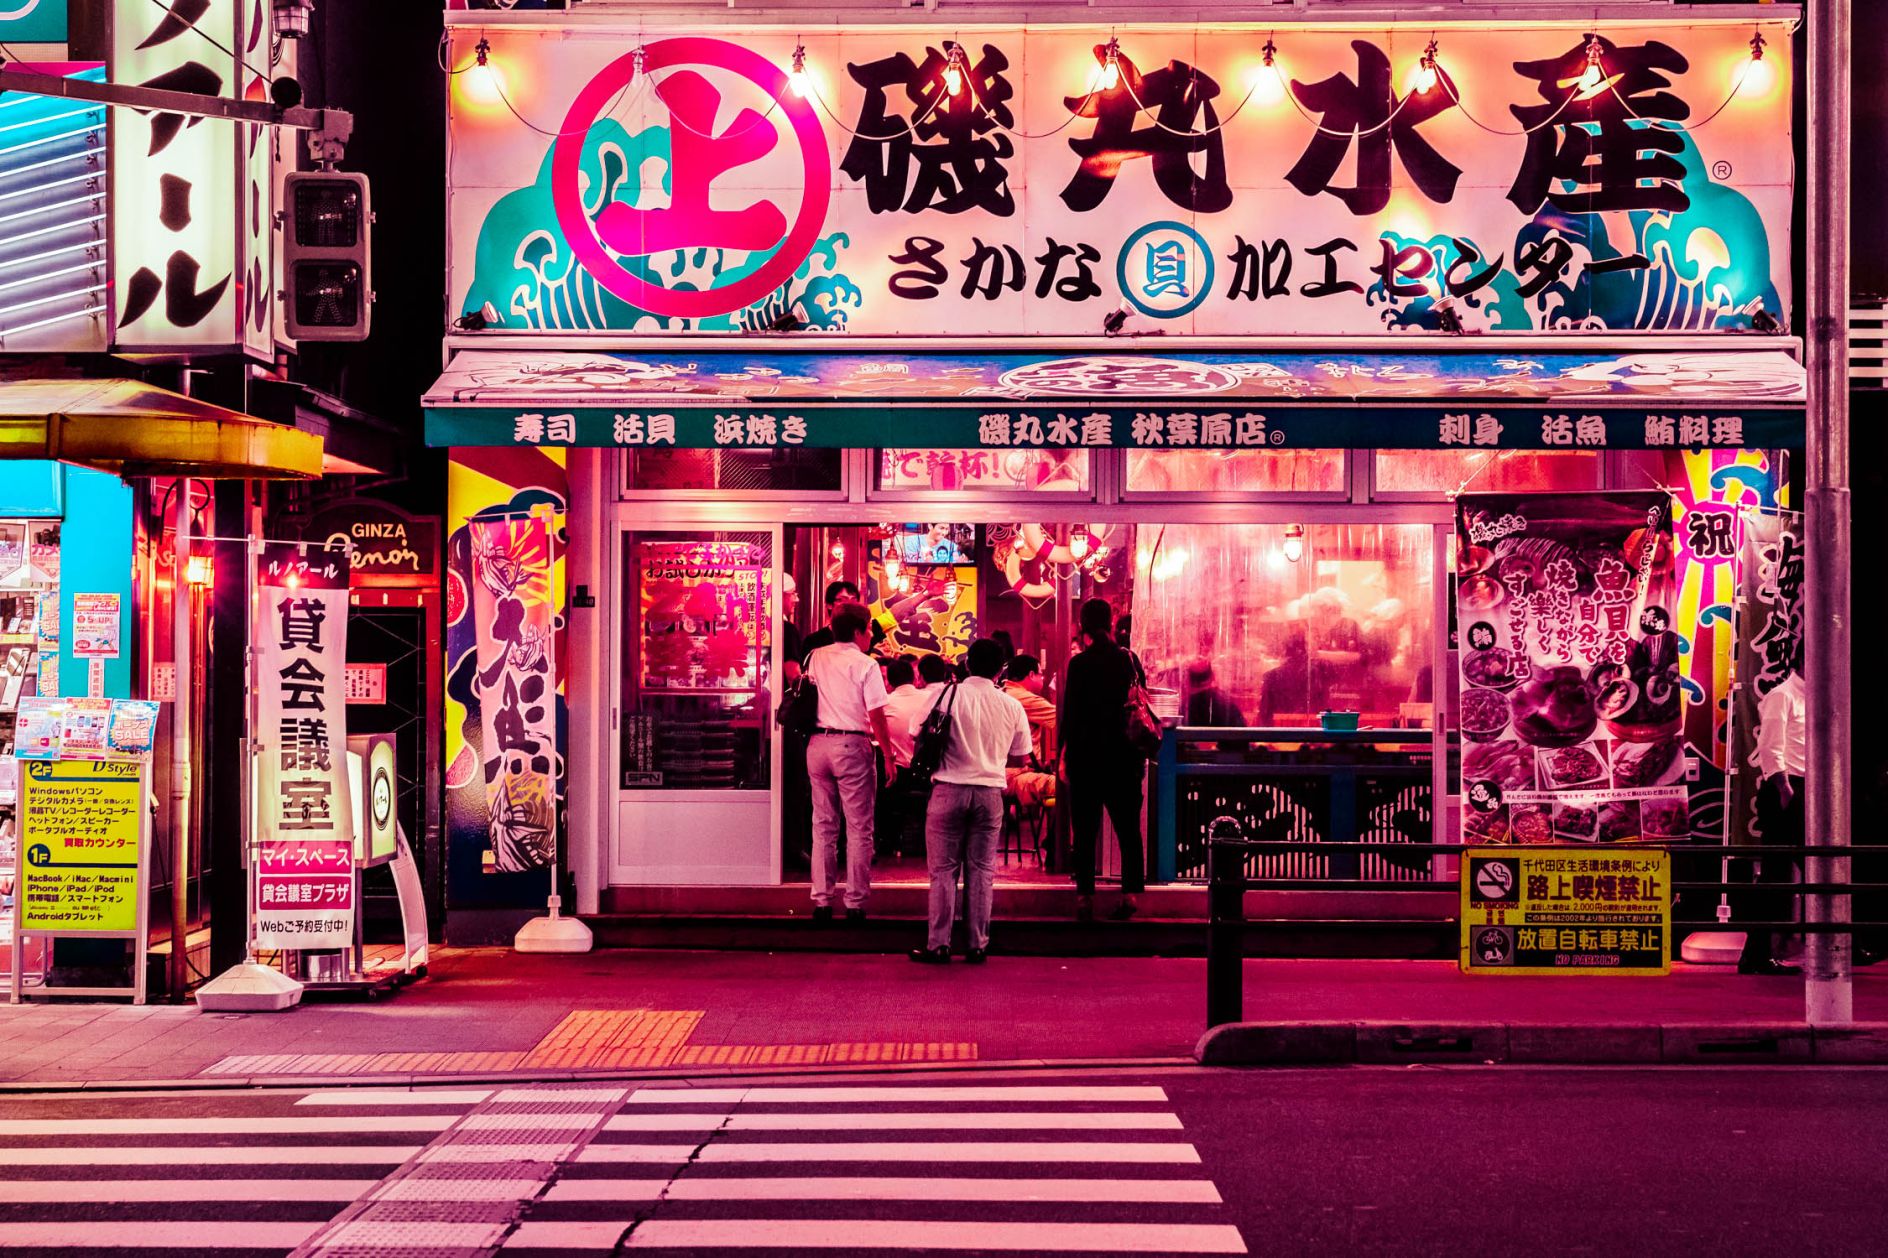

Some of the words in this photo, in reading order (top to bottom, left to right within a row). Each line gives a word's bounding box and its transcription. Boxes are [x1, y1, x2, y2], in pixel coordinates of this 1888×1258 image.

[840, 33, 1691, 217] 磯丸水産
[514, 413, 577, 443] 寿司
[614, 413, 676, 445] 活貝
[714, 414, 808, 445] 浜焼き
[978, 412, 1113, 446] 磯丸水産
[1131, 412, 1267, 446] 秋葉原店
[1439, 413, 1504, 446] 刺身
[1542, 413, 1607, 446] 活魚
[1644, 413, 1745, 446] 鮪料理
[352, 522, 407, 538] GINZA
[1688, 511, 1736, 558] 祝
[268, 560, 339, 579] ルノアール
[1544, 558, 1579, 663] 焼きながら
[1591, 557, 1637, 665] 魚貝を
[1503, 571, 1532, 679] すごせる店
[1526, 590, 1555, 655] 楽しく
[1577, 598, 1602, 666] 自分で
[277, 596, 334, 831] 貸会議室
[114, 729, 149, 741] SALE
[31, 762, 52, 777] 2F
[108, 763, 137, 776] Style
[29, 787, 103, 796] Windowsパソコン
[28, 826, 108, 835] ポータブルオーディオ
[64, 837, 136, 848] 買取カウンター
[31, 847, 49, 863] 1F
[261, 848, 350, 867] マイ・スペース
[261, 883, 350, 904] 貸会議室プラザ
[1526, 875, 1662, 901] 路上喫煙禁止
[1470, 902, 1482, 910] NO
[1483, 902, 1519, 910] SMOKING
[27, 911, 104, 921] Androidタブレット
[260, 919, 348, 933] Webご予約受付中!
[1517, 928, 1660, 951] 放置自転車禁止
[1555, 954, 1570, 966] NO
[1572, 954, 1620, 966] PARKING
